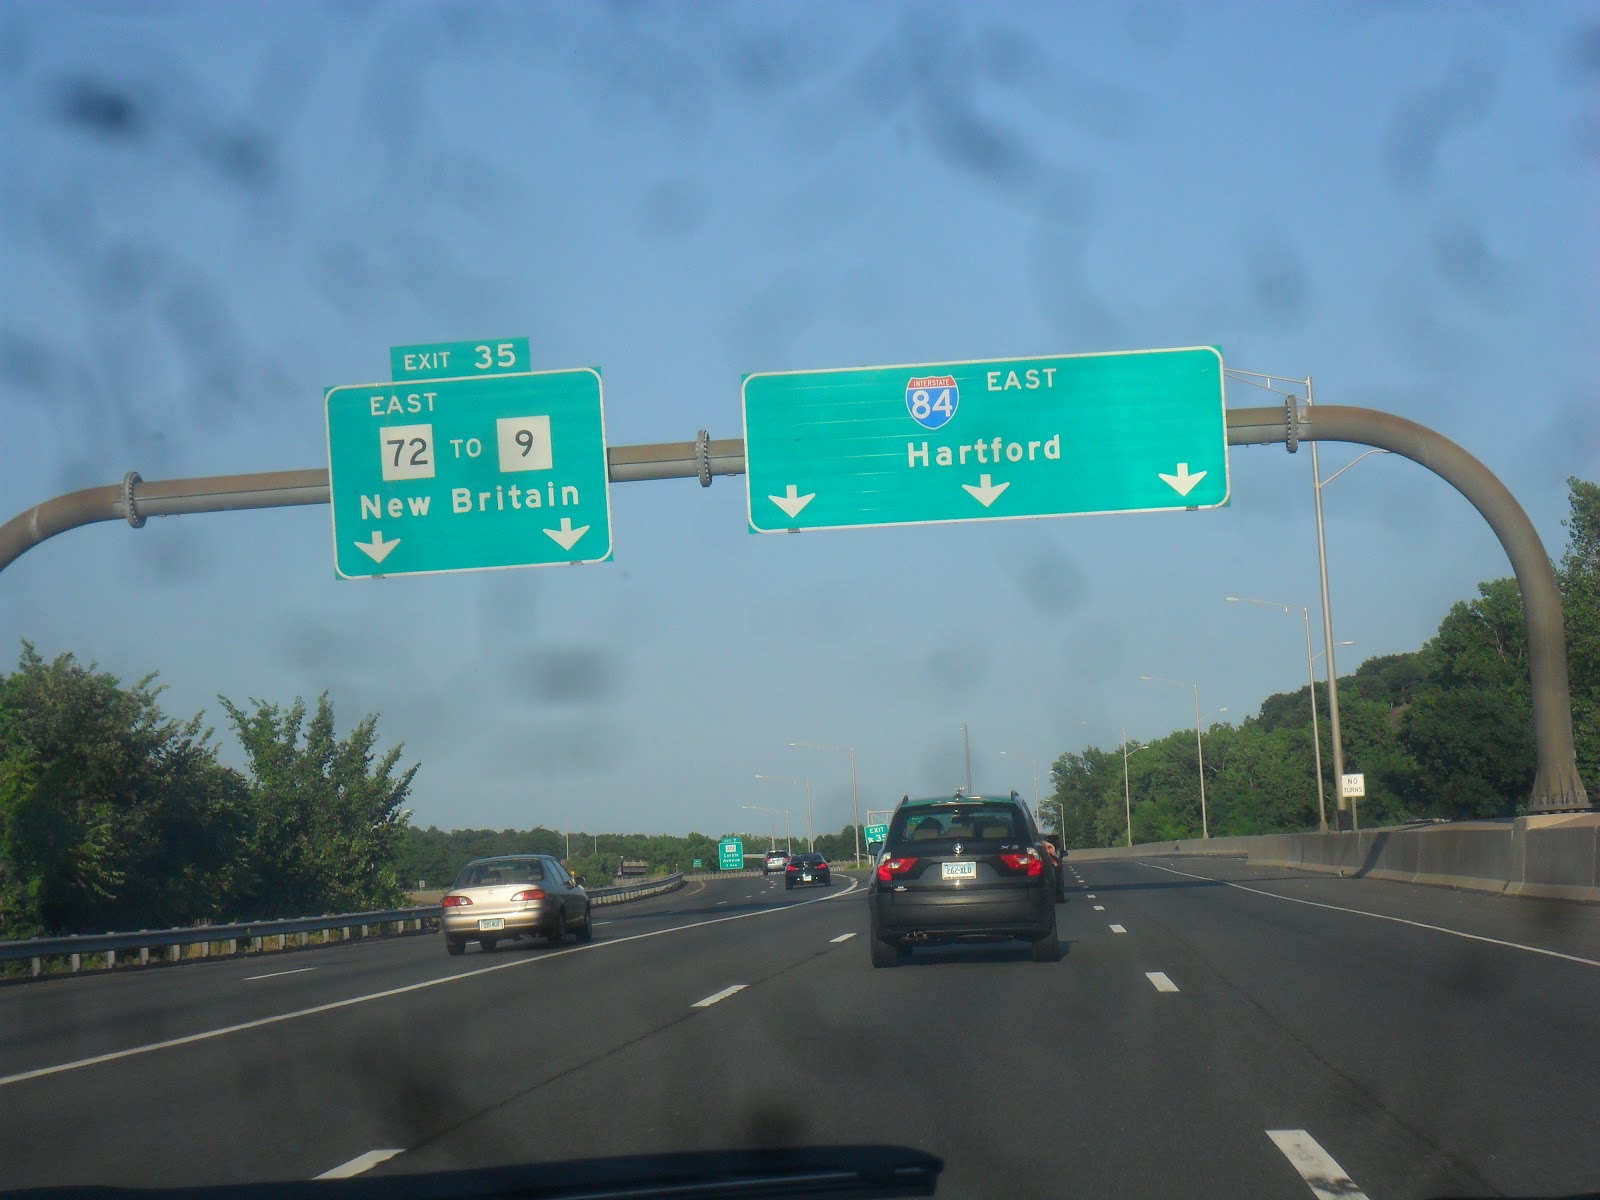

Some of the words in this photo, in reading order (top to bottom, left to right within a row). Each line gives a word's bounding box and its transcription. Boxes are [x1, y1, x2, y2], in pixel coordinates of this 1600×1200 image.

[404, 351, 450, 371] EXIT
[474, 343, 516, 369] 35
[913, 378, 950, 388] INTERSTATE
[987, 368, 1057, 392] EAST
[370, 392, 437, 416] EAST
[911, 388, 953, 419] 84
[386, 437, 428, 467] 72
[450, 438, 482, 459] TO
[515, 429, 533, 457] 9
[907, 433, 1061, 468] Hartford
[360, 493, 431, 520] New
[451, 481, 579, 514] Britain
[869, 826, 885, 834] EXIT
